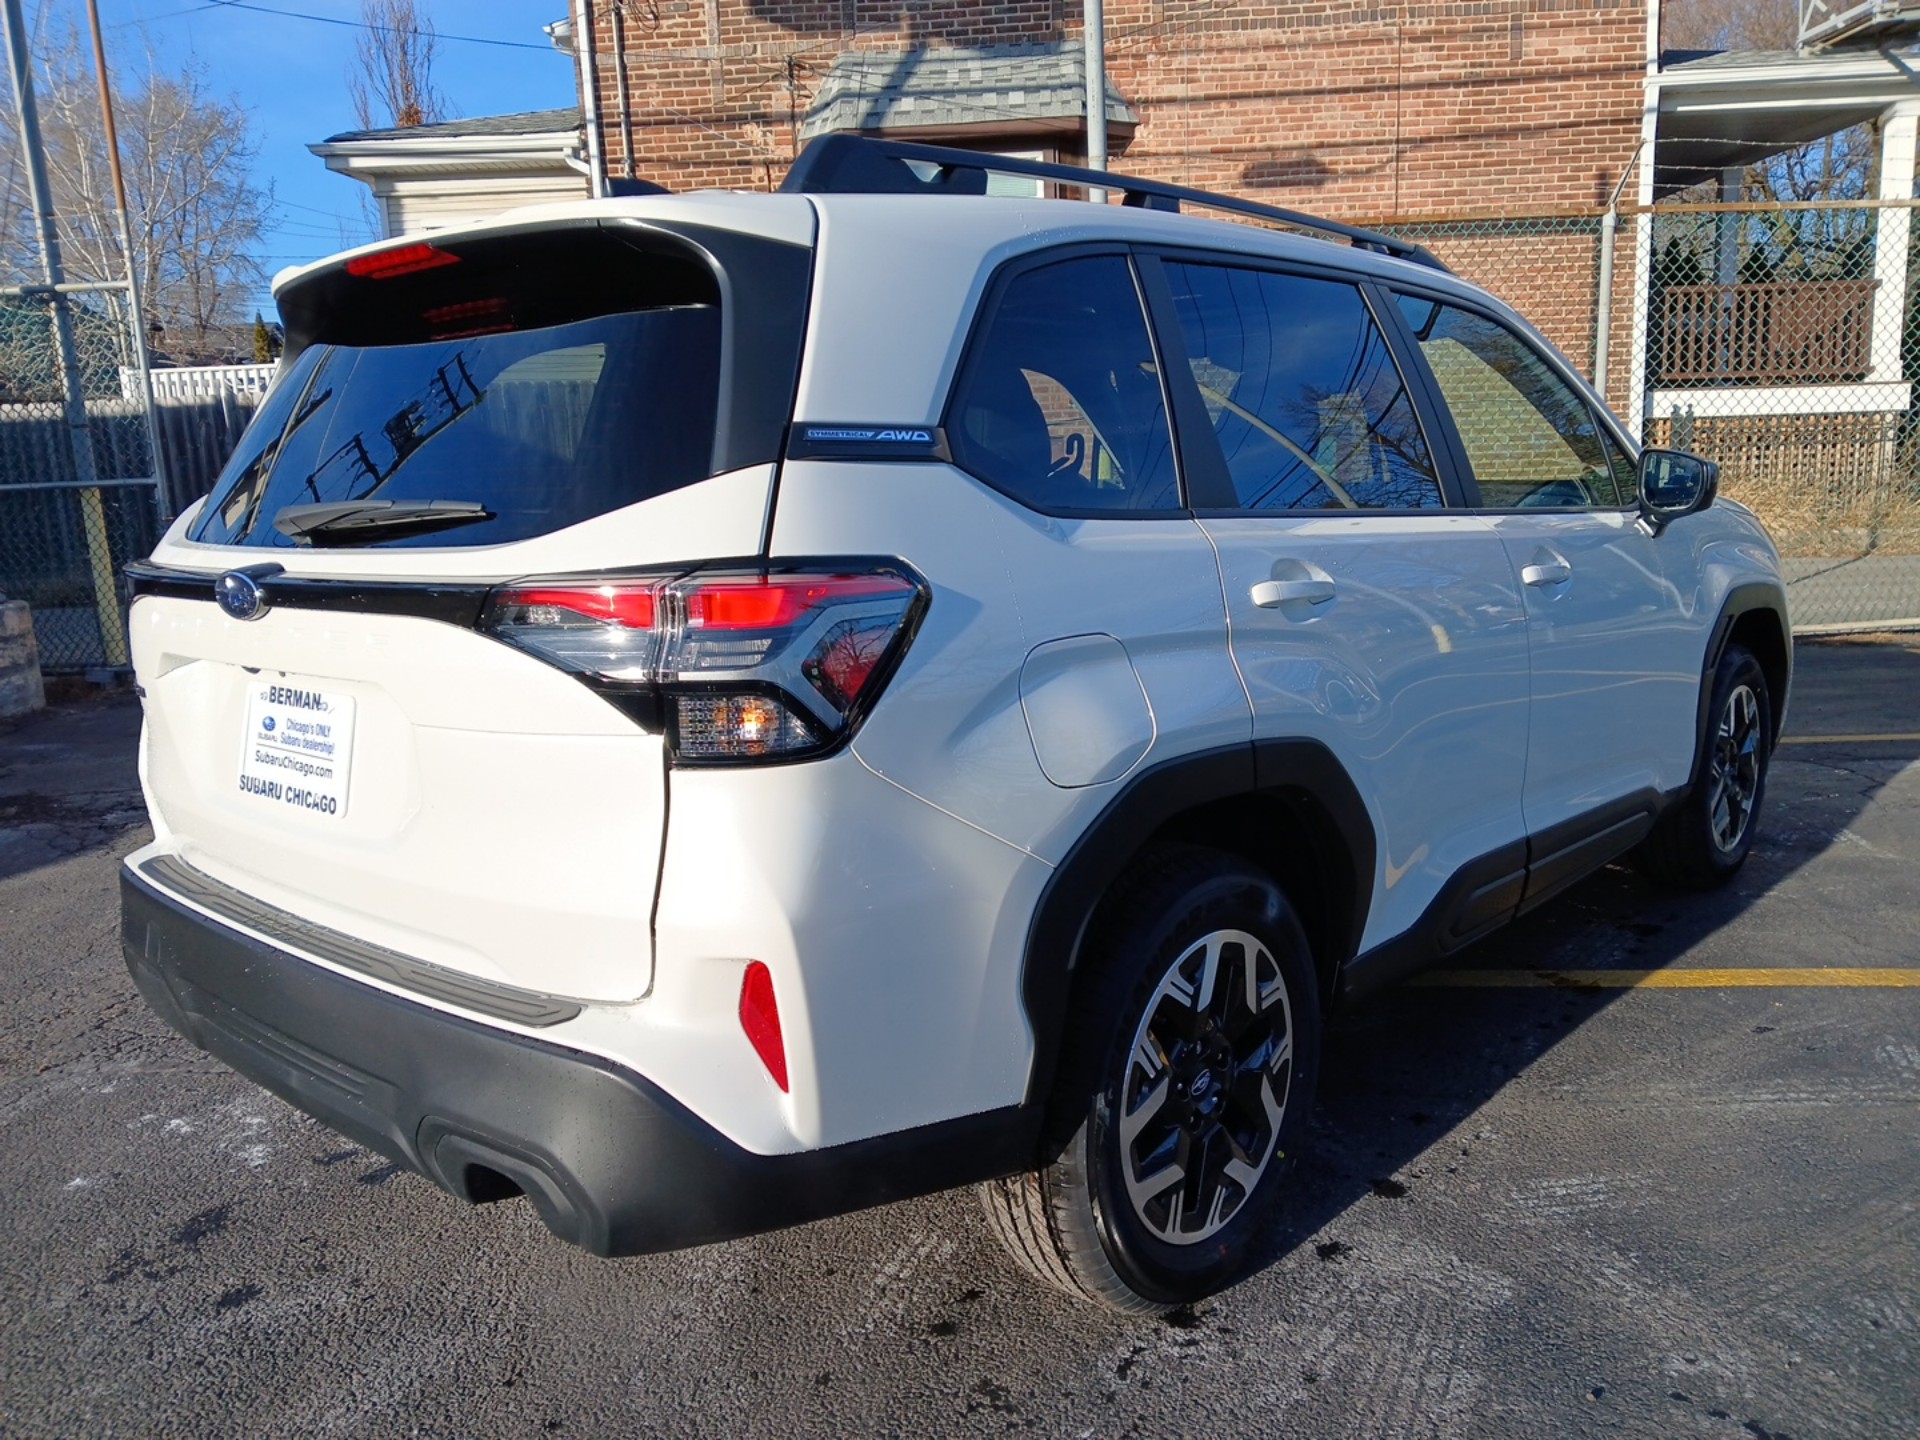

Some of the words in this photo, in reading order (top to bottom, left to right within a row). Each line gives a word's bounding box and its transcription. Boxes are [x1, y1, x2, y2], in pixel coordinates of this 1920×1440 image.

[876, 430, 930, 441] AWD
[268, 685, 322, 711] BERMAN
[280, 732, 301, 747] Subaru
[286, 718, 314, 735] Chicago's
[315, 723, 331, 738] ONLY
[255, 749, 333, 779] SubaruChicago.com
[239, 774, 283, 800] SUBARU
[285, 786, 337, 815] CHICAGO
